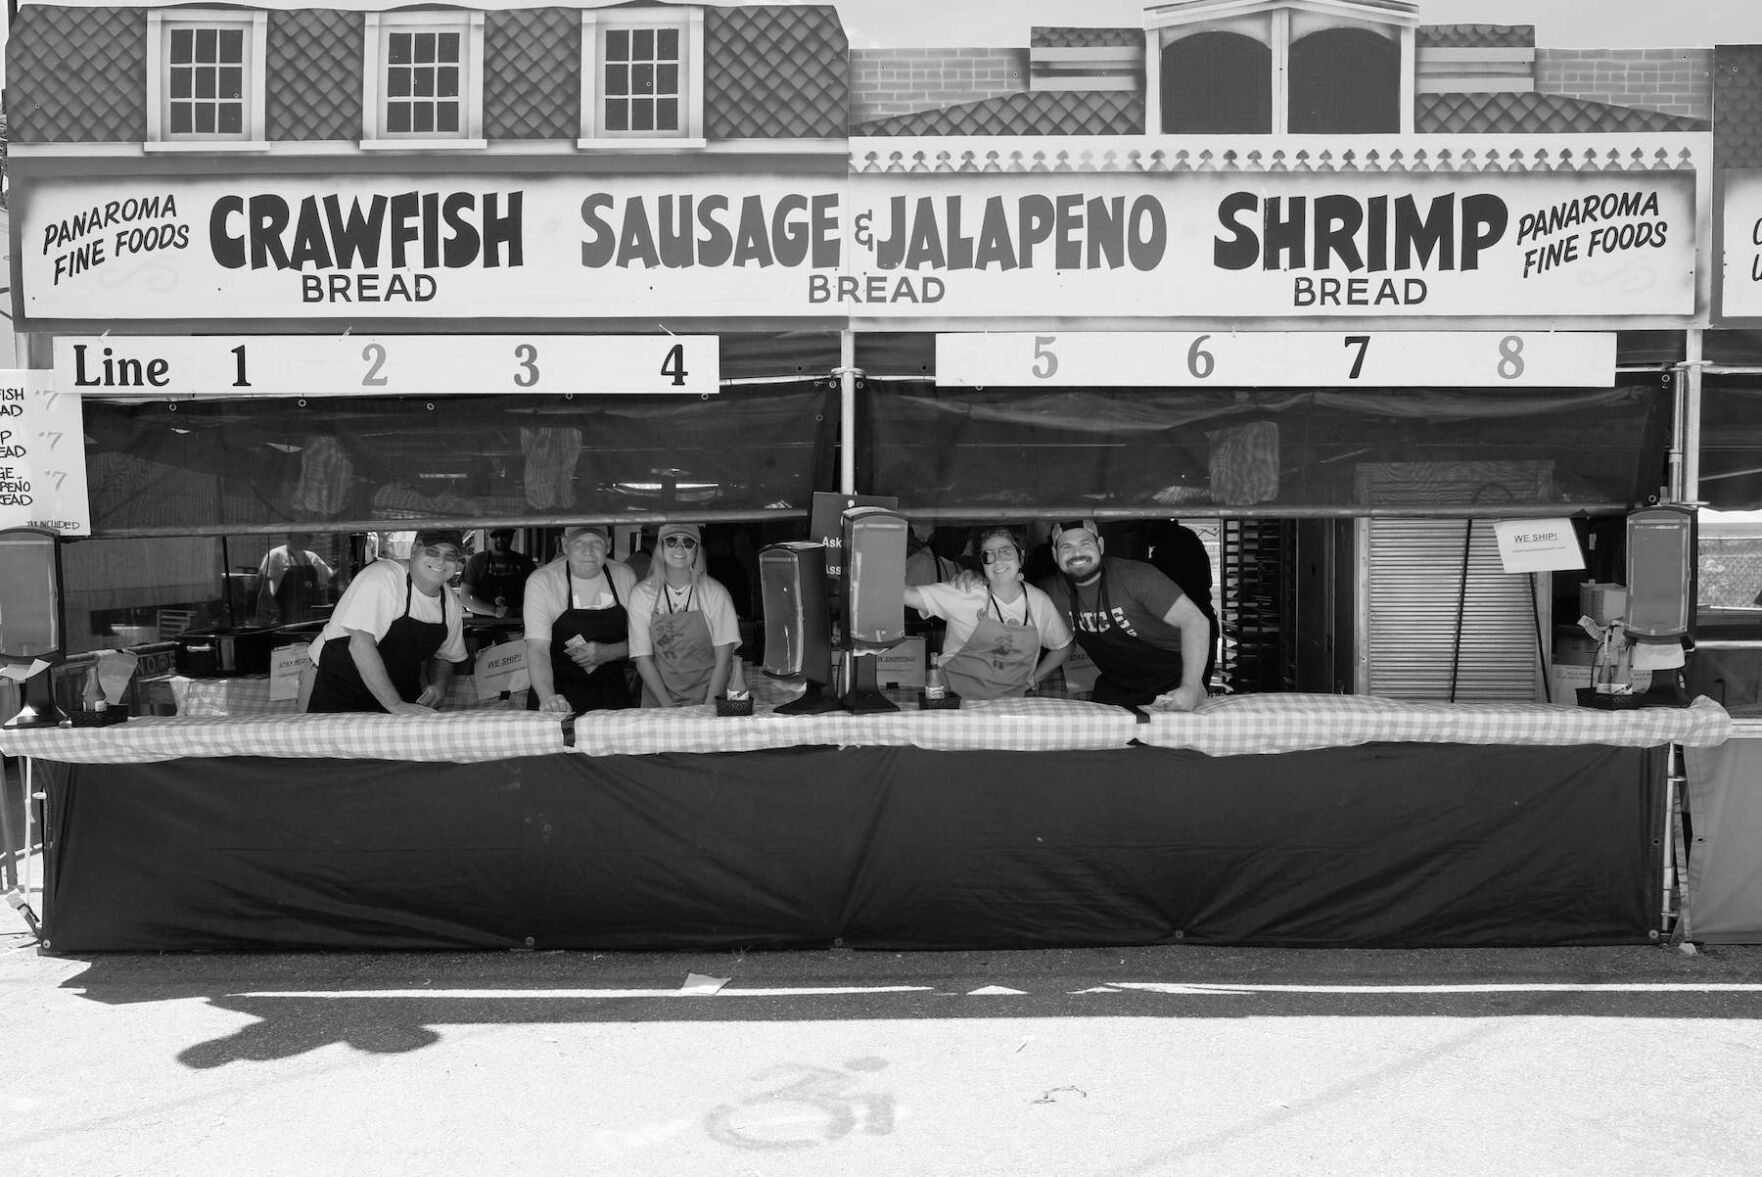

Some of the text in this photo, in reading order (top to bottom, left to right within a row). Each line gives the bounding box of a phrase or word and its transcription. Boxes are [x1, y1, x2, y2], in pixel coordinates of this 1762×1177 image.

[42, 194, 177, 256] PANAROMA
[209, 190, 524, 272] CRAWFISH
[580, 192, 842, 270] SAUSAGE
[876, 192, 1168, 272] JALAPENO
[1213, 191, 1509, 273] SHRIMP
[1516, 191, 1659, 246] PANAROMA
[53, 223, 190, 286] FINE FOODS
[1523, 220, 1668, 279] FINE FOODS
[301, 273, 437, 303] BREAD
[808, 274, 945, 304] BREAD
[1294, 276, 1428, 307] BREAD
[73, 343, 689, 388] Line 1 2 3 4
[1031, 334, 1525, 380] 5 6 7 8
[0, 387, 24, 401] ISH
[822, 536, 842, 548] Ask
[1514, 532, 1558, 543] WE SHIP!
